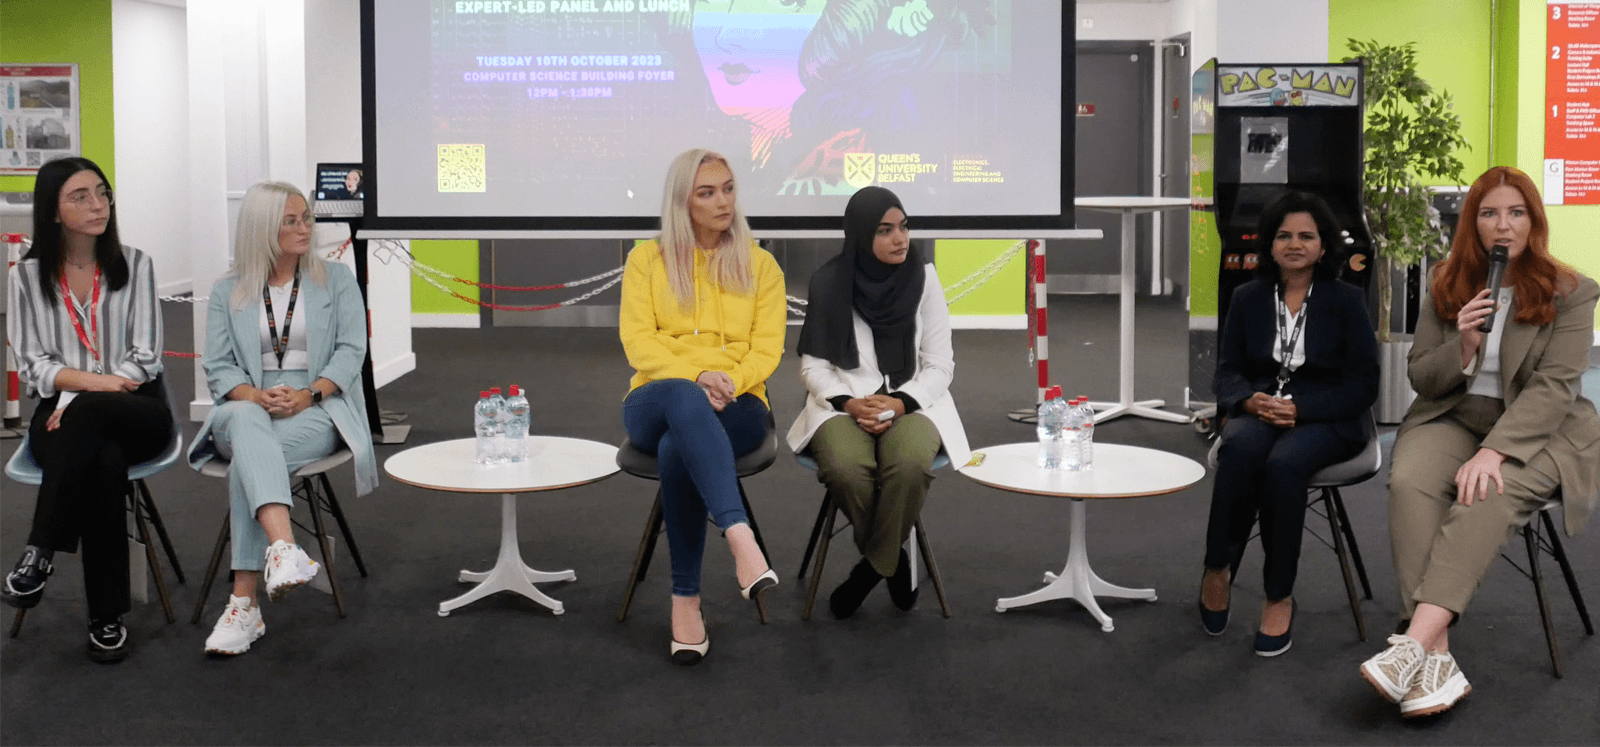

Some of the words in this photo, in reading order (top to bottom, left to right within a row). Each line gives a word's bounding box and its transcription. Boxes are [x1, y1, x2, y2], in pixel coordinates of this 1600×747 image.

[455, 0, 546, 14] EXPERT-LED
[550, 0, 599, 13] PANEL
[603, 0, 635, 13] AND
[638, 0, 690, 12] LUNCH
[1552, 6, 1561, 20] 3
[1551, 45, 1561, 60] 2
[476, 55, 532, 67] TUESDAY
[536, 55, 568, 66] 10TH
[570, 55, 628, 66] OCTOBER
[631, 54, 662, 66] 2023
[463, 71, 527, 82] COMPUTER
[529, 71, 579, 81] SCIENCE
[581, 70, 635, 81] BUILDING
[637, 70, 675, 81] FOYER
[1219, 67, 1357, 99] PAC-MAN
[526, 87, 560, 99] 12PM
[570, 86, 613, 98] 1:30PM
[1552, 105, 1559, 118] 1
[878, 153, 921, 164] QUEEN'S
[878, 163, 938, 174] UNIVERSITY
[1550, 162, 1559, 173] G
[878, 173, 916, 183] BELFAST
